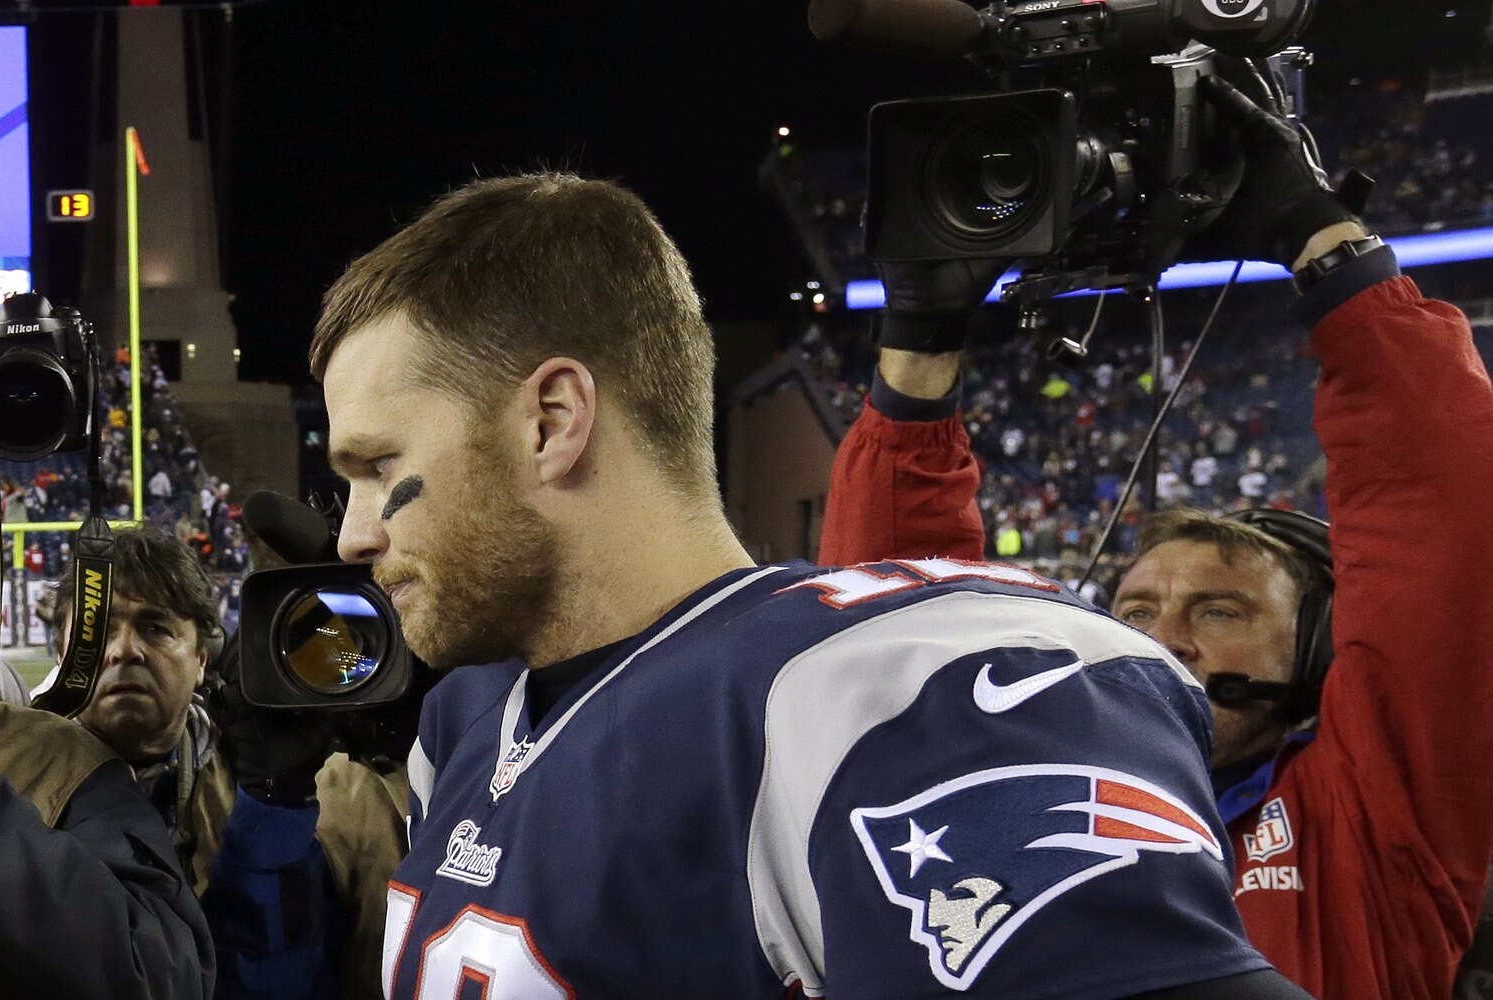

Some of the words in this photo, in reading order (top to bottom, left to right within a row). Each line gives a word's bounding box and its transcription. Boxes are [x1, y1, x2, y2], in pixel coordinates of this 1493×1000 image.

[1024, 1, 1061, 12] SONY
[61, 193, 89, 217] 13
[7, 323, 40, 335] Nikon
[82, 568, 103, 642] Nikon
[65, 646, 98, 689] D4
[449, 837, 502, 875] Patriots
